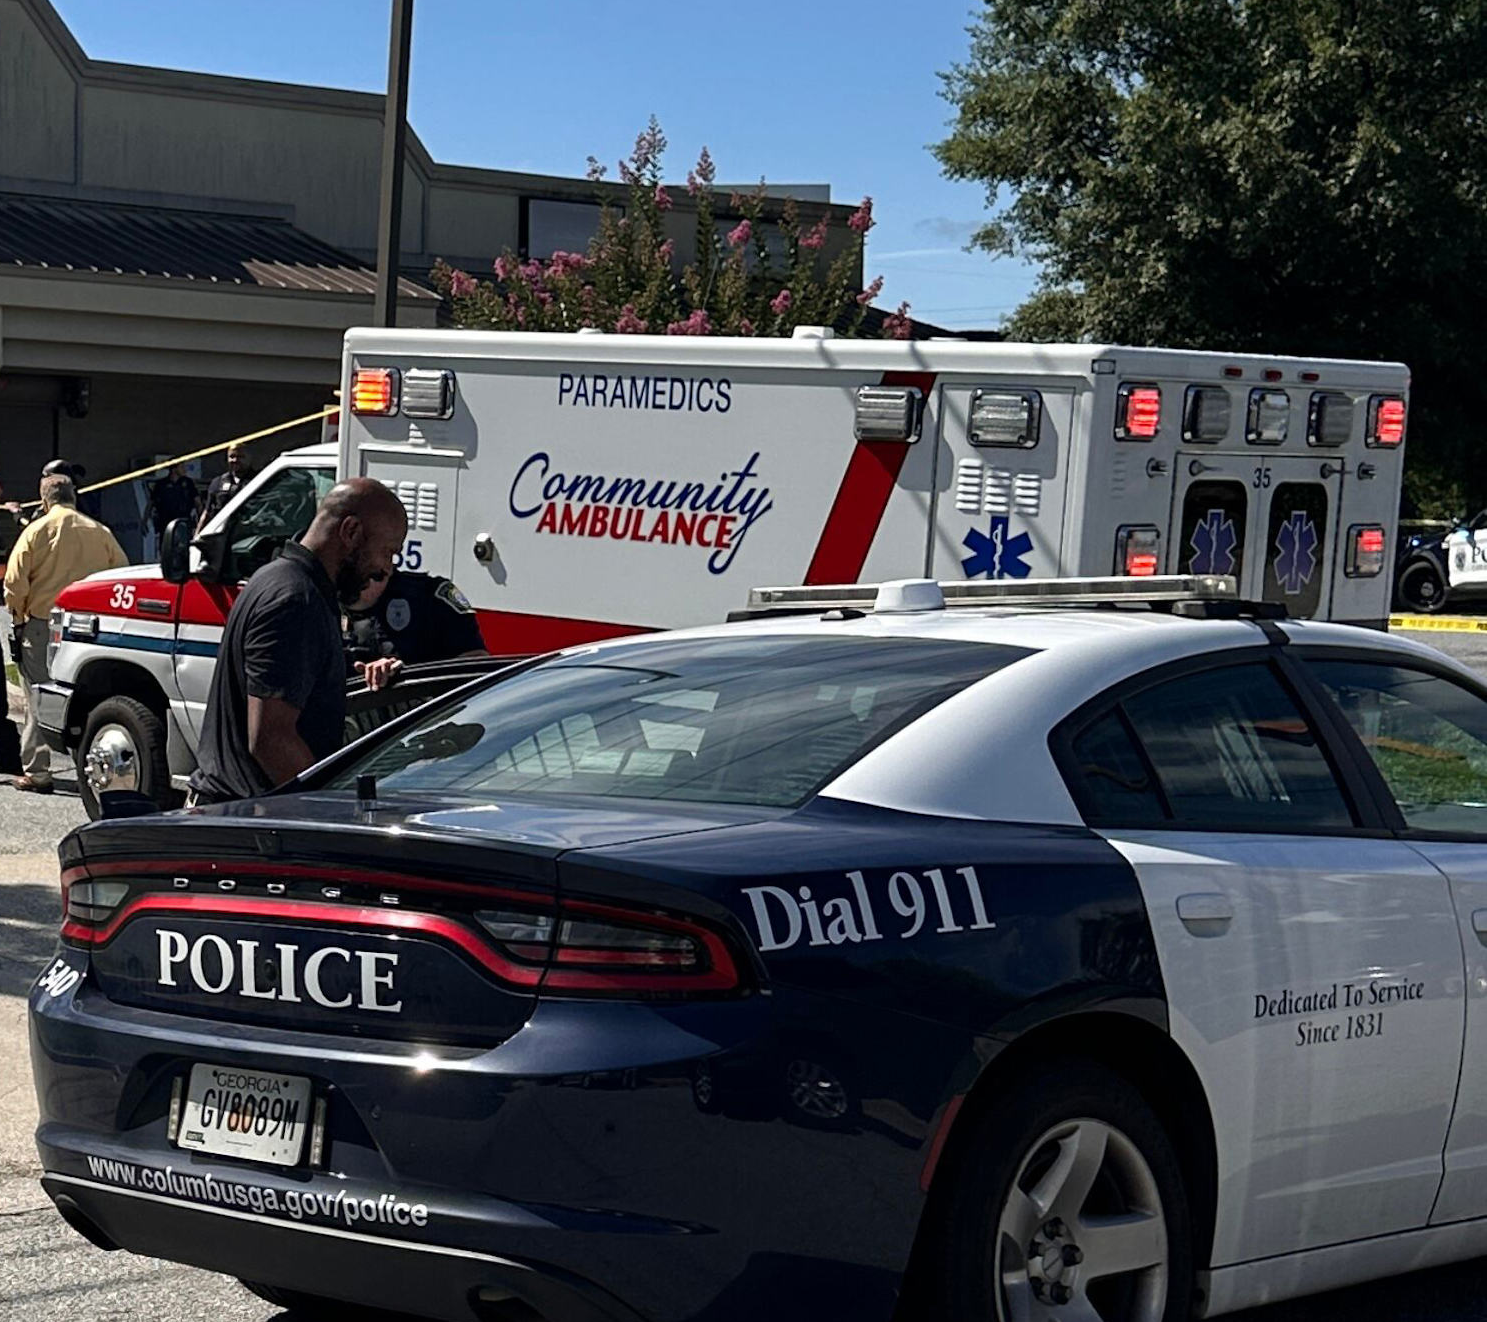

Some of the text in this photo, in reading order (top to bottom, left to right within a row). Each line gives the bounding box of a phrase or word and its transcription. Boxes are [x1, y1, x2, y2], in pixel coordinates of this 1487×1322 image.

[558, 373, 732, 413] PARAMEDICS
[1253, 467, 1271, 489] 35
[509, 451, 773, 574] Community
[535, 501, 737, 549] AMBULANCE
[109, 583, 136, 610] 35
[173, 877, 400, 905] DODGE
[740, 866, 996, 952] Dial 911
[155, 928, 402, 1014] POLICE
[1254, 978, 1424, 1018] Dedicated To Service
[1295, 1012, 1383, 1046] Since 1831
[217, 1072, 281, 1094] GEORGIA
[201, 1088, 299, 1141] GV8089M
[87, 1154, 428, 1227] www.columbusga.gov/police
